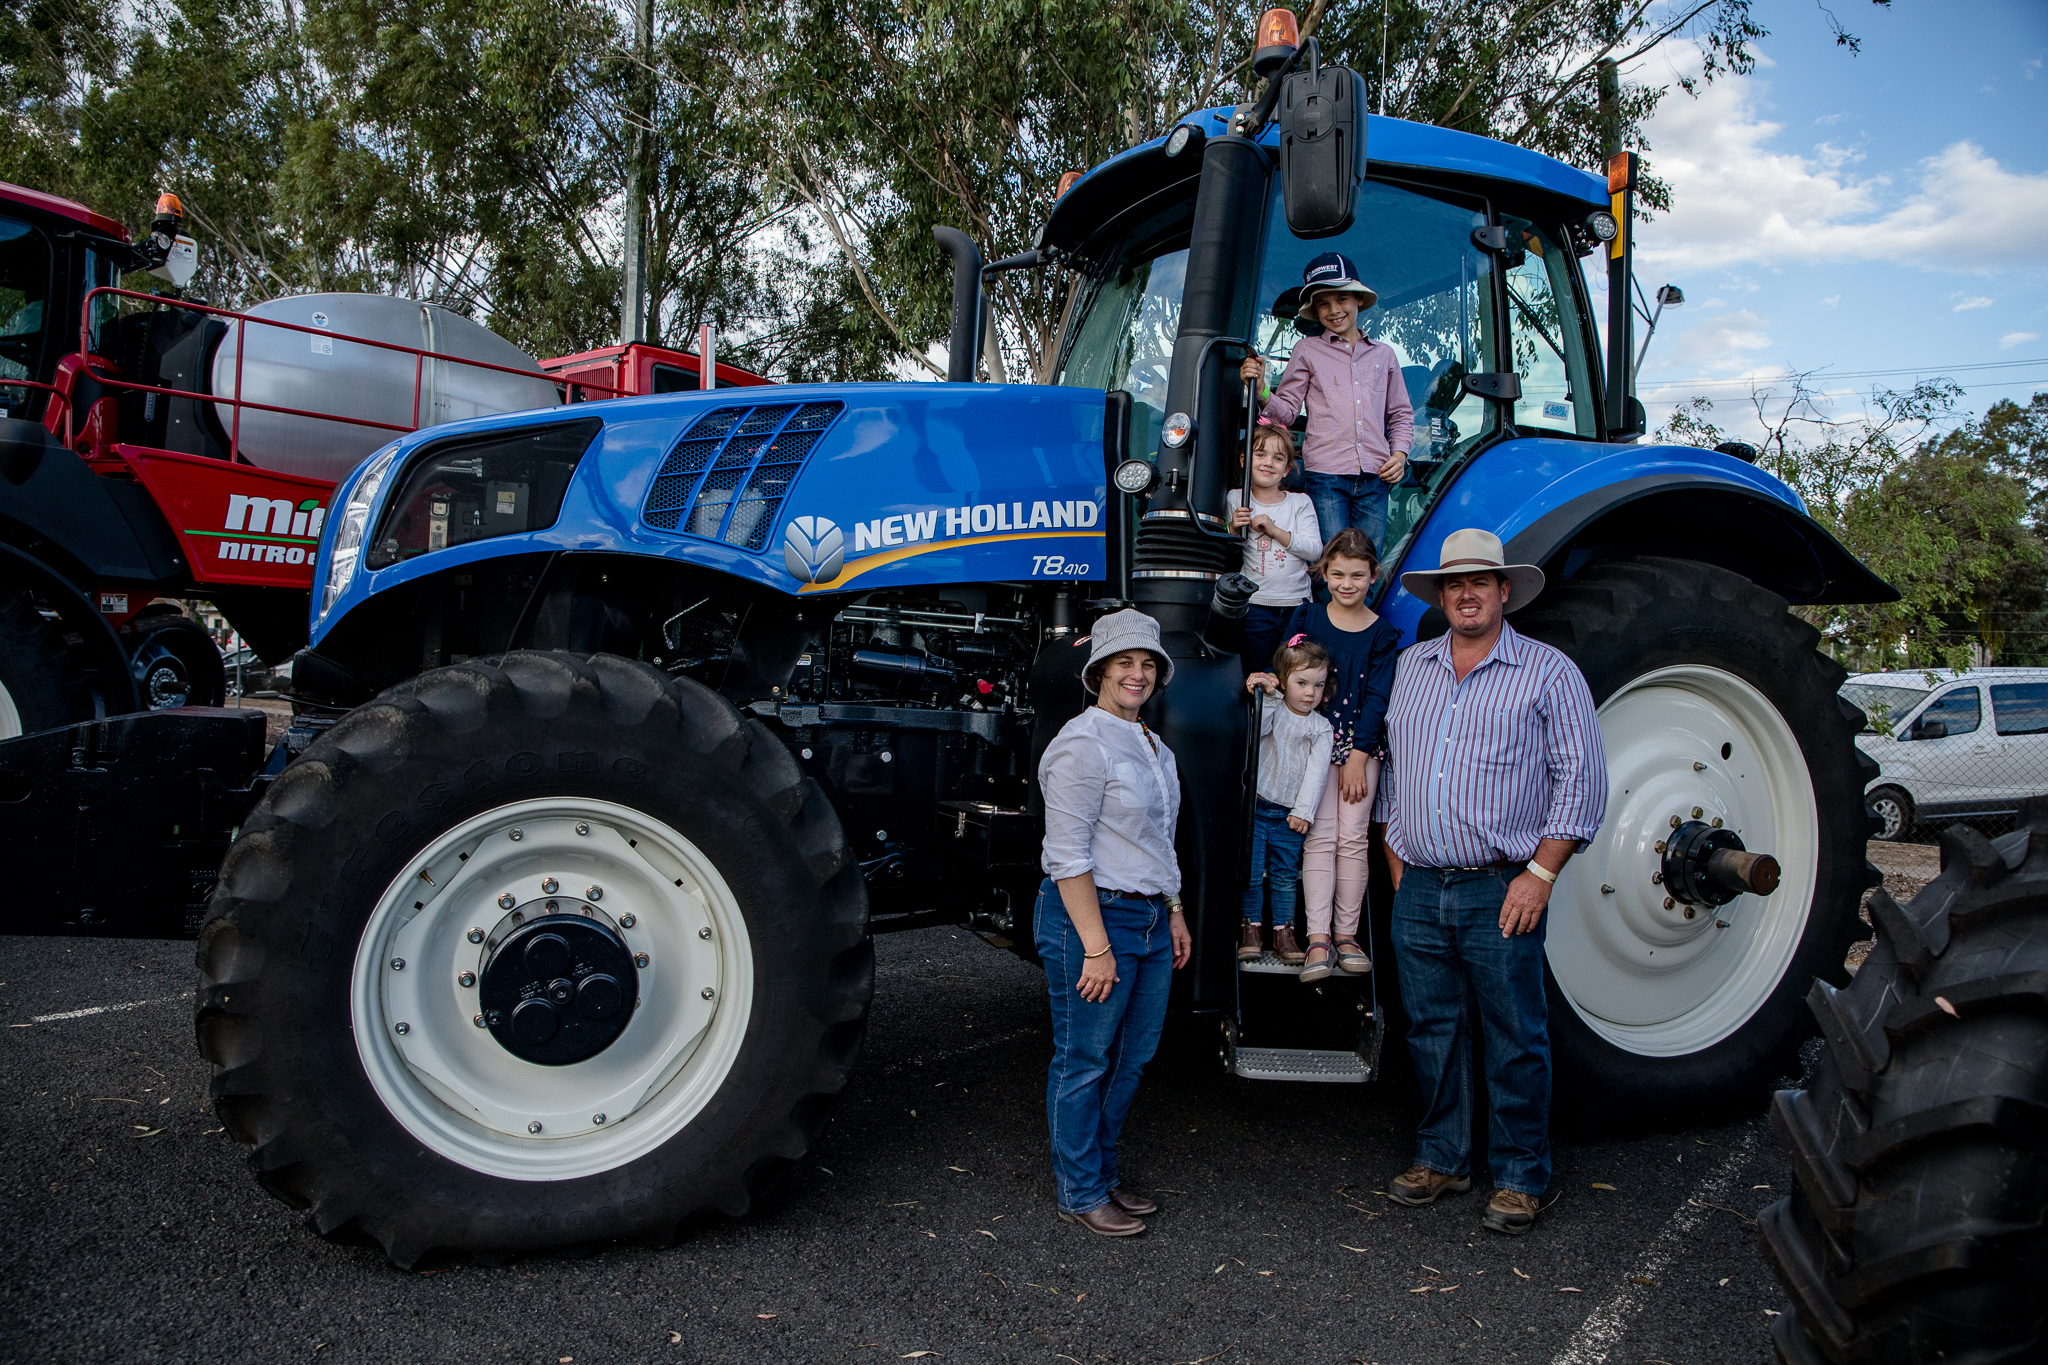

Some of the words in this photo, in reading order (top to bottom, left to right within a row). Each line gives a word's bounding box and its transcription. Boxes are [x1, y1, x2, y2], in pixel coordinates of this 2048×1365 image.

[855, 510, 938, 552] NEW
[946, 500, 1098, 536] HOLLAND
[1031, 555, 1090, 576] T8.410
